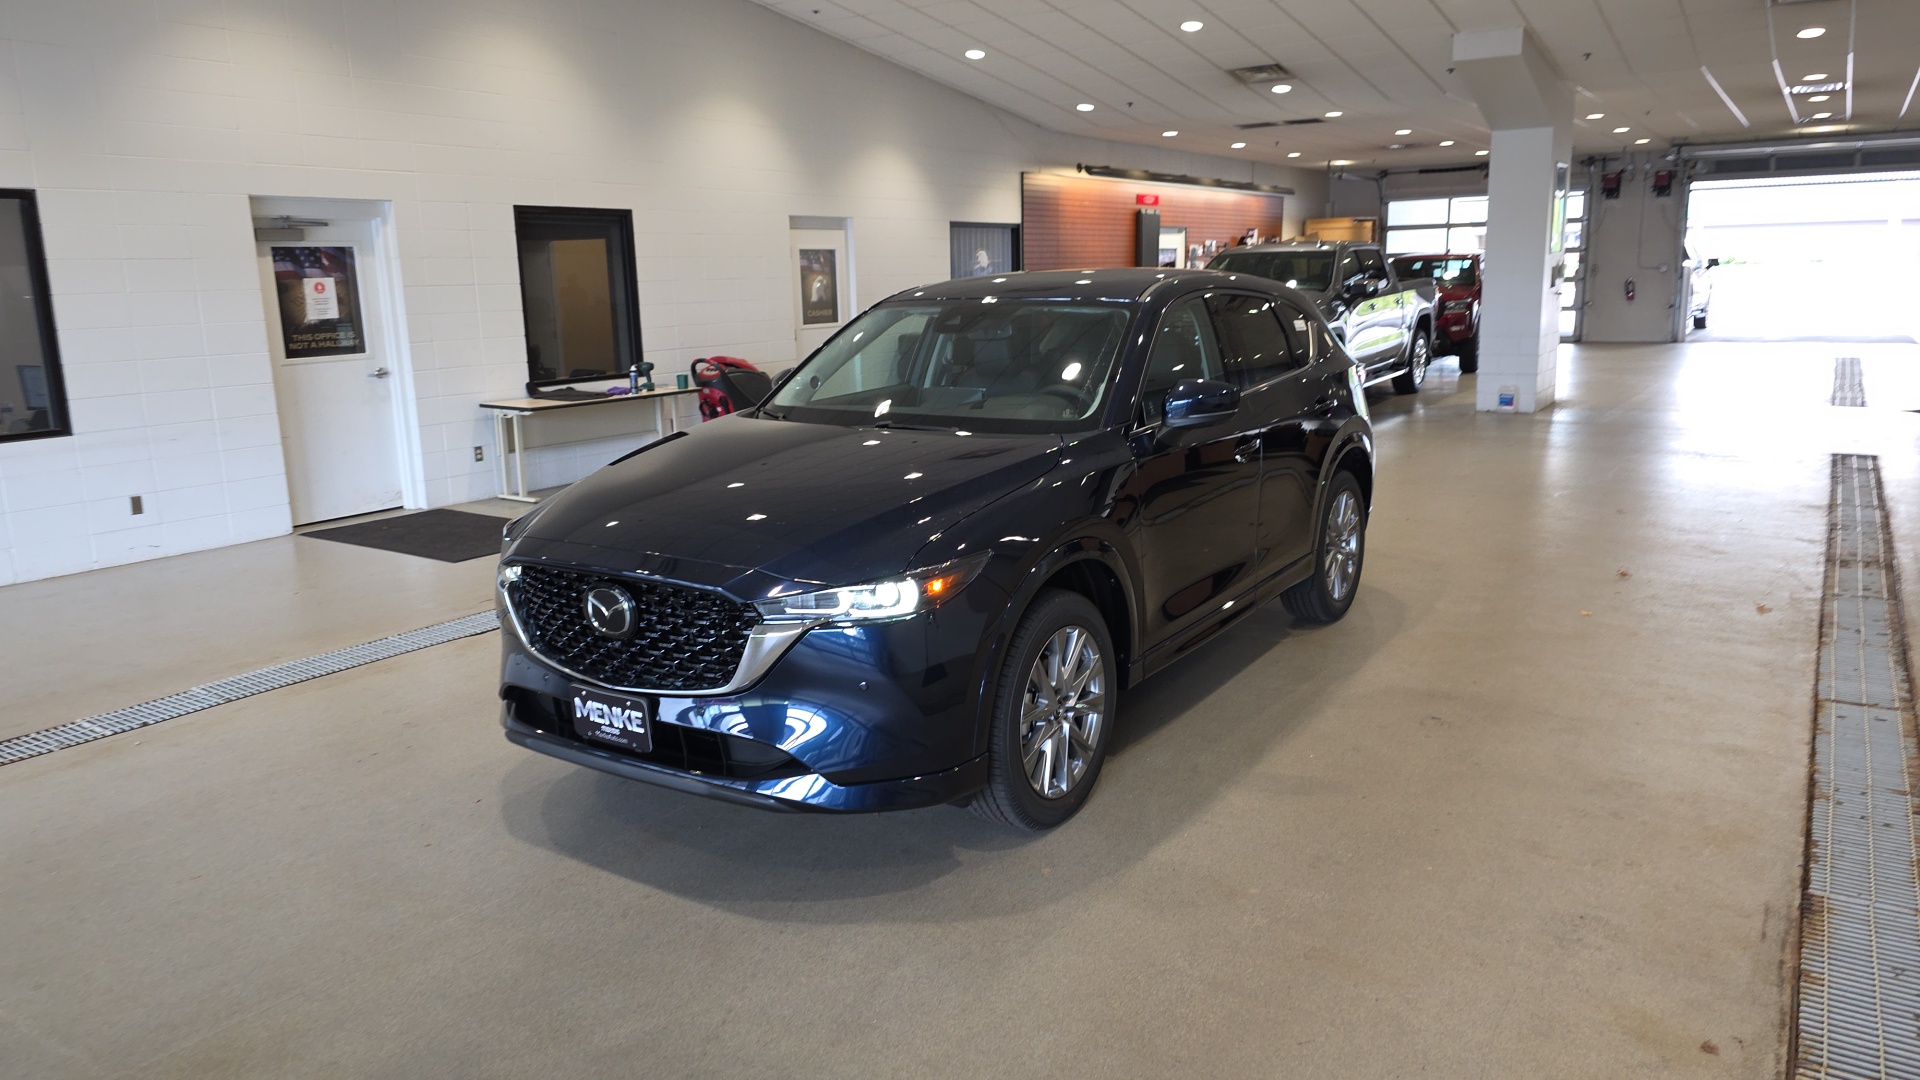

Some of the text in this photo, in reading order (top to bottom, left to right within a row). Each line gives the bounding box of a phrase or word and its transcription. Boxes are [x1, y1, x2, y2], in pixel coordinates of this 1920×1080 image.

[807, 309, 833, 317] CASHIER
[314, 331, 346, 340] OFFICE
[289, 342, 309, 350] NOT
[310, 341, 318, 349] A
[574, 697, 645, 733] MENKE
